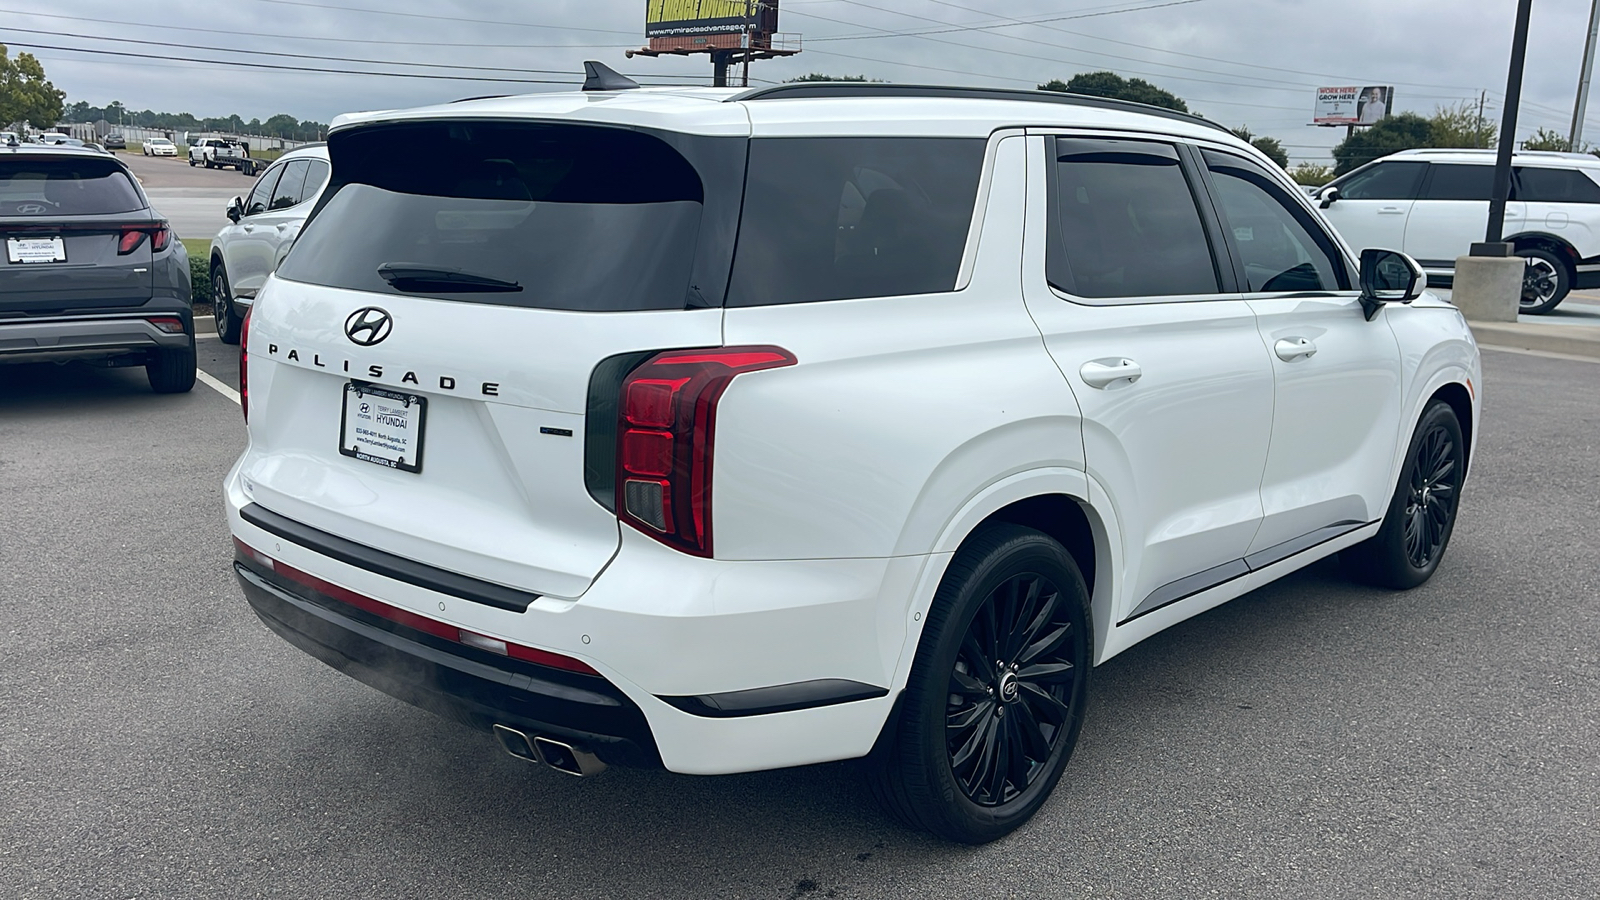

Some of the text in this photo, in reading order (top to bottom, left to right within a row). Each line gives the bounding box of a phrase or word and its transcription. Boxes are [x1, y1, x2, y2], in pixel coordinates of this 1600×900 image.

[648, 23, 757, 35] www.mymiracleadvantage.cm
[269, 343, 500, 396] PALISADE
[387, 392, 404, 400] HYUNDAI
[390, 407, 408, 417] LAMBERT
[376, 414, 408, 429] HYUNDAI
[378, 432, 387, 440] North
[356, 452, 371, 462] NORTH
[370, 456, 390, 467] AUGUSTA,
